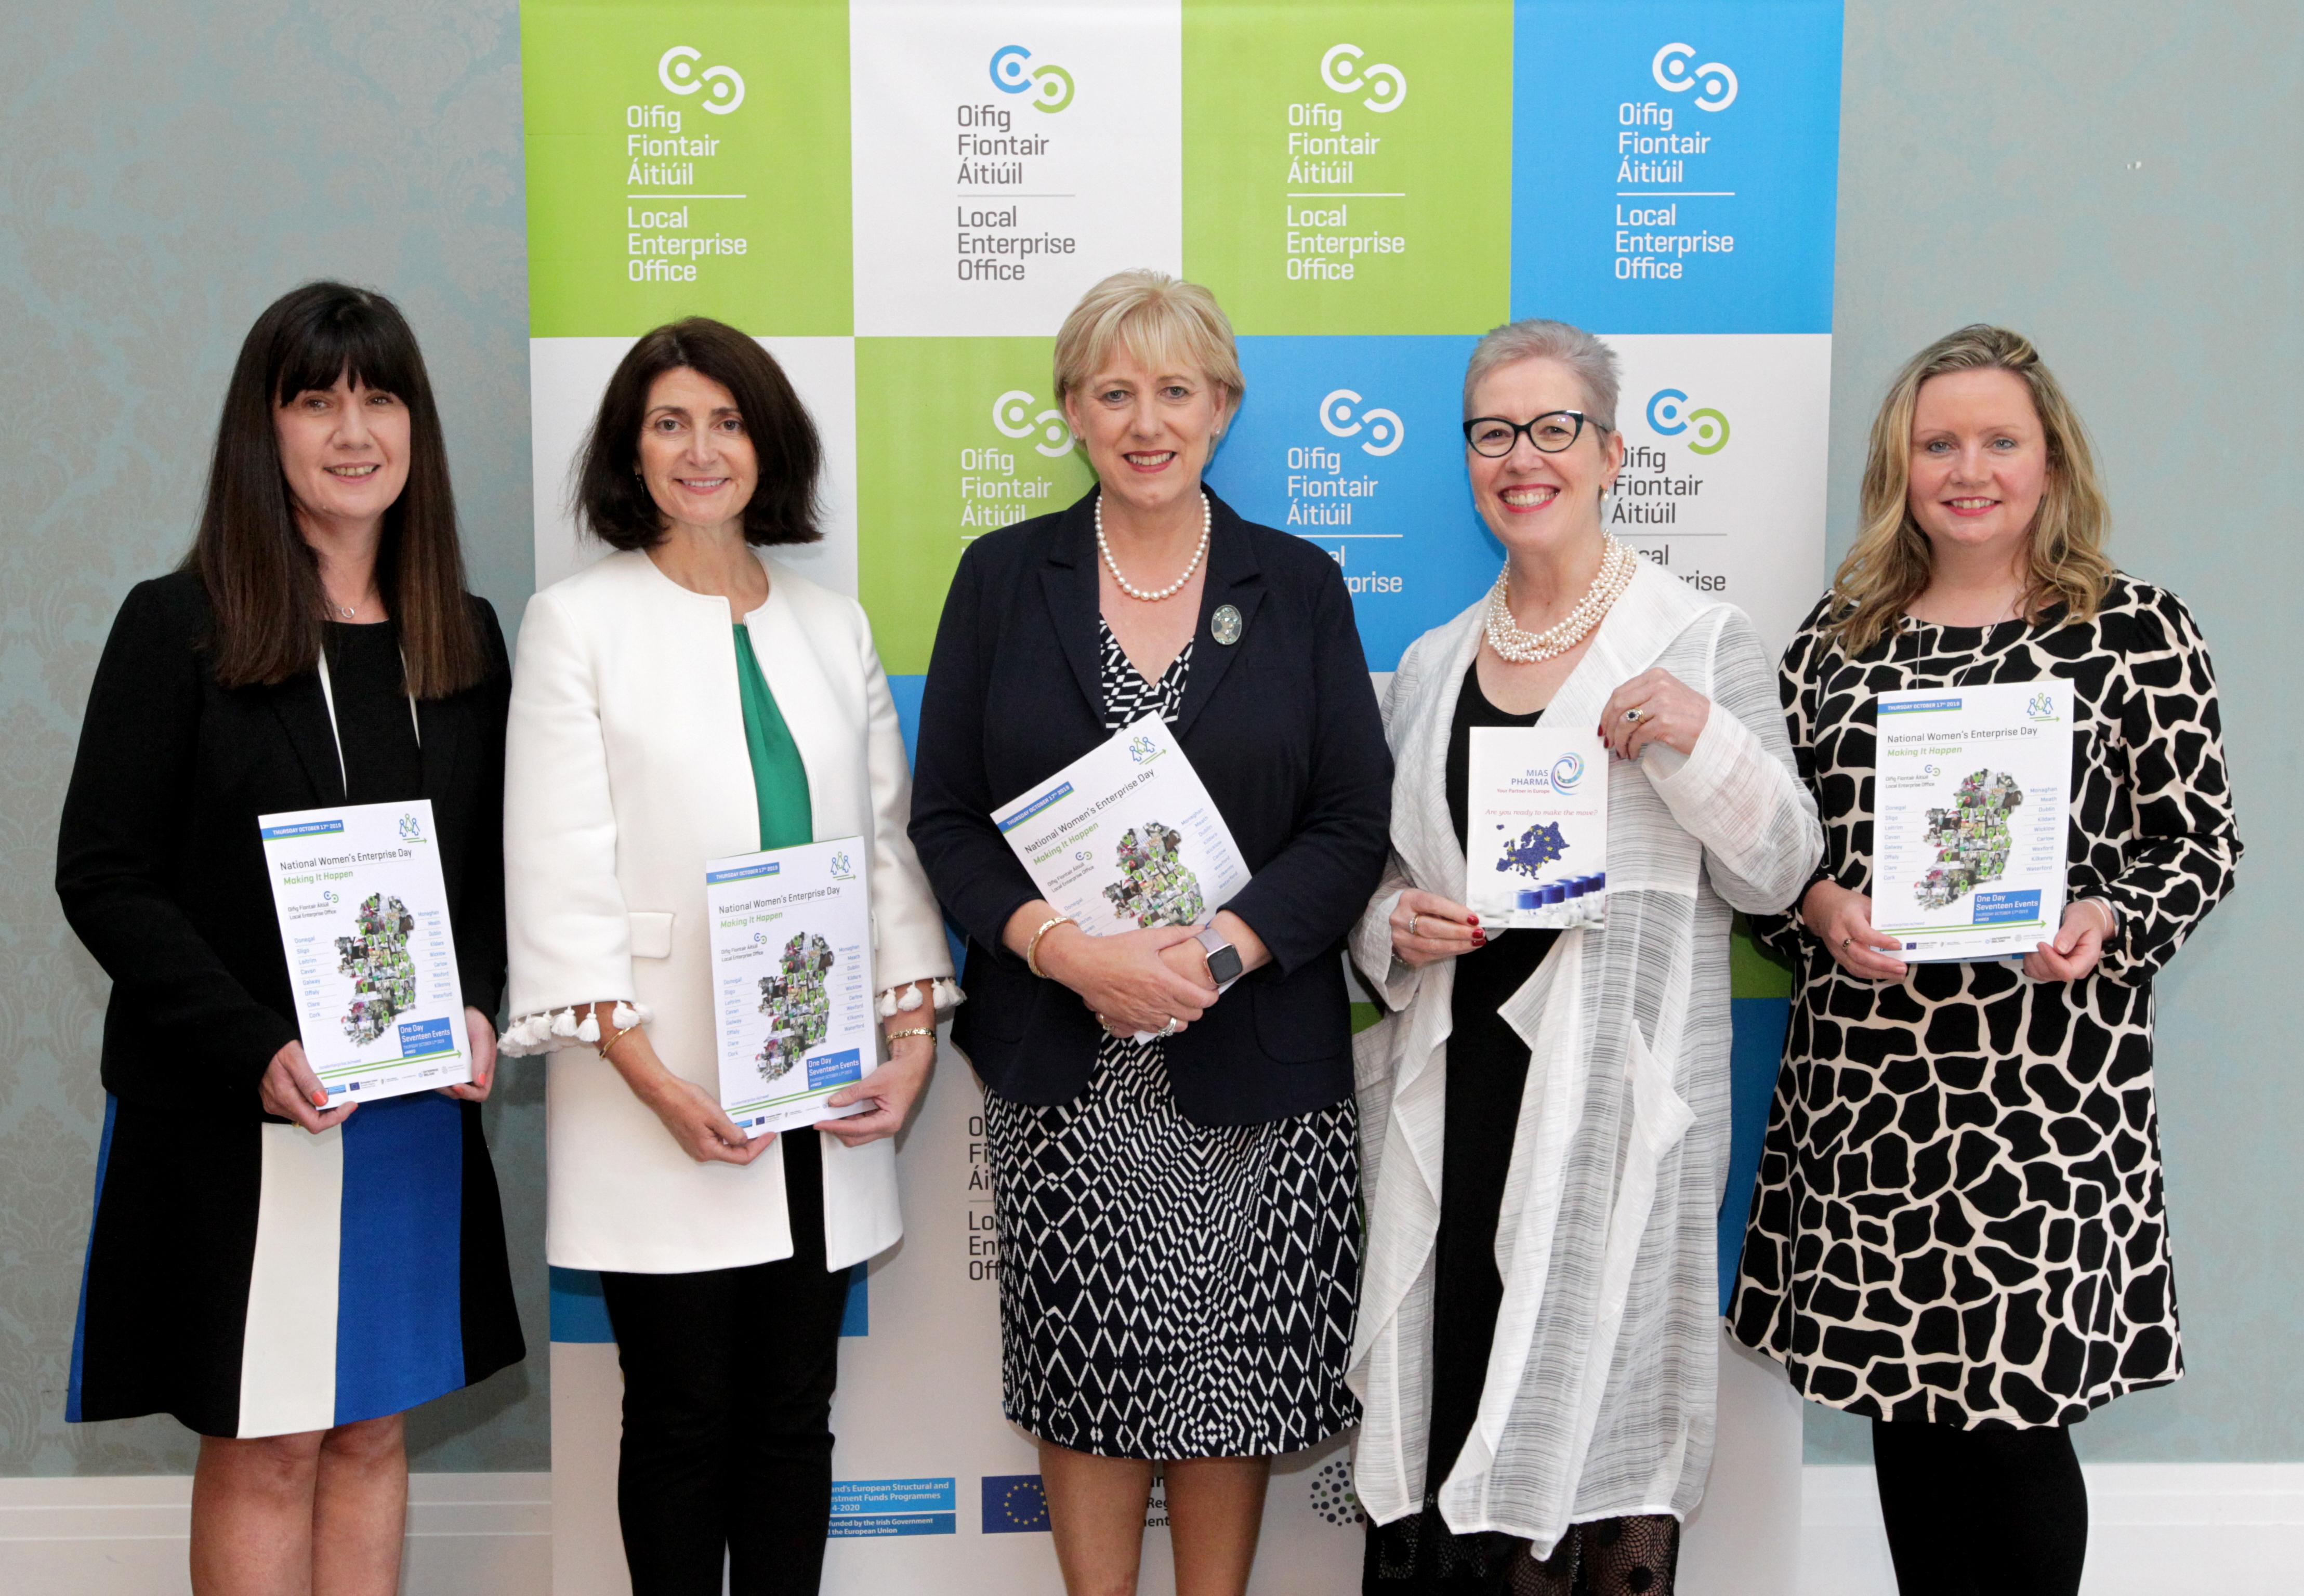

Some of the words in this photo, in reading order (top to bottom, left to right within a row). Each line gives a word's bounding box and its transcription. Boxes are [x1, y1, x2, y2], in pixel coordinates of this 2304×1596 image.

[627, 105, 681, 134] Oifig
[958, 105, 1010, 133] Oifig
[1288, 103, 1342, 132] Oifig
[1620, 102, 1673, 130] Oifig
[628, 134, 720, 156] Fiontair
[959, 134, 1049, 155] Fiontair
[1289, 133, 1380, 154] Fiontair
[1620, 131, 1710, 154] Fiontair
[627, 157, 693, 185] Áitiúil
[957, 157, 1022, 184] Áitiúil
[1287, 155, 1353, 183] Áitiúil
[1617, 155, 1682, 182] Áitiúil
[628, 206, 688, 229] Local
[958, 206, 1016, 227] Local
[1287, 204, 1347, 227] Local
[1617, 204, 1676, 226] Local
[628, 233, 747, 260] Enterprise
[958, 232, 1075, 259] Enterprise
[1287, 231, 1405, 259] Enterprise
[1616, 230, 1733, 258] Enterprise
[629, 259, 696, 281] Office
[958, 259, 1024, 280] Office
[1287, 258, 1354, 280] Office
[1615, 257, 1682, 279] Office
[962, 448, 1015, 476] Oifig
[1288, 447, 1340, 474] Oifig
[962, 477, 1054, 498] Fiontair
[1288, 476, 1378, 497] Fiontair
[1613, 474, 1703, 495] Fiontair
[960, 499, 1025, 526] Áitiúil
[1287, 498, 1351, 525] Áitiúil
[1612, 497, 1675, 523] Áitiúil
[1344, 571, 1402, 597] prise
[1888, 734, 1924, 743] National
[1927, 731, 1968, 740] Women's
[1971, 729, 2018, 738] Enterprise
[2021, 727, 2037, 736] Day
[1888, 748, 1918, 757] Making
[1929, 747, 1962, 756] Happen
[1024, 829, 1058, 853] National
[1058, 808, 1096, 833] Women's
[1096, 781, 1138, 810] Enterprise
[1138, 769, 1154, 782] Day
[1033, 846, 1062, 865] Making
[1069, 823, 1098, 844] Happen
[280, 859, 317, 870] National
[318, 854, 356, 865] Women's
[358, 851, 397, 861] Enterprise
[398, 849, 411, 858] Day
[284, 876, 314, 885] Making
[324, 871, 353, 880] Happen
[719, 901, 752, 914] National
[754, 896, 786, 908] Women's
[789, 890, 825, 902] Enterprise
[827, 887, 840, 895] Day
[721, 918, 747, 928] Making
[757, 913, 783, 922] Happen
[402, 1033, 431, 1043] Seventeen
[809, 1065, 839, 1076] Seventeen
[840, 1060, 859, 1069] Events
[970, 1260, 1000, 1280] Off
